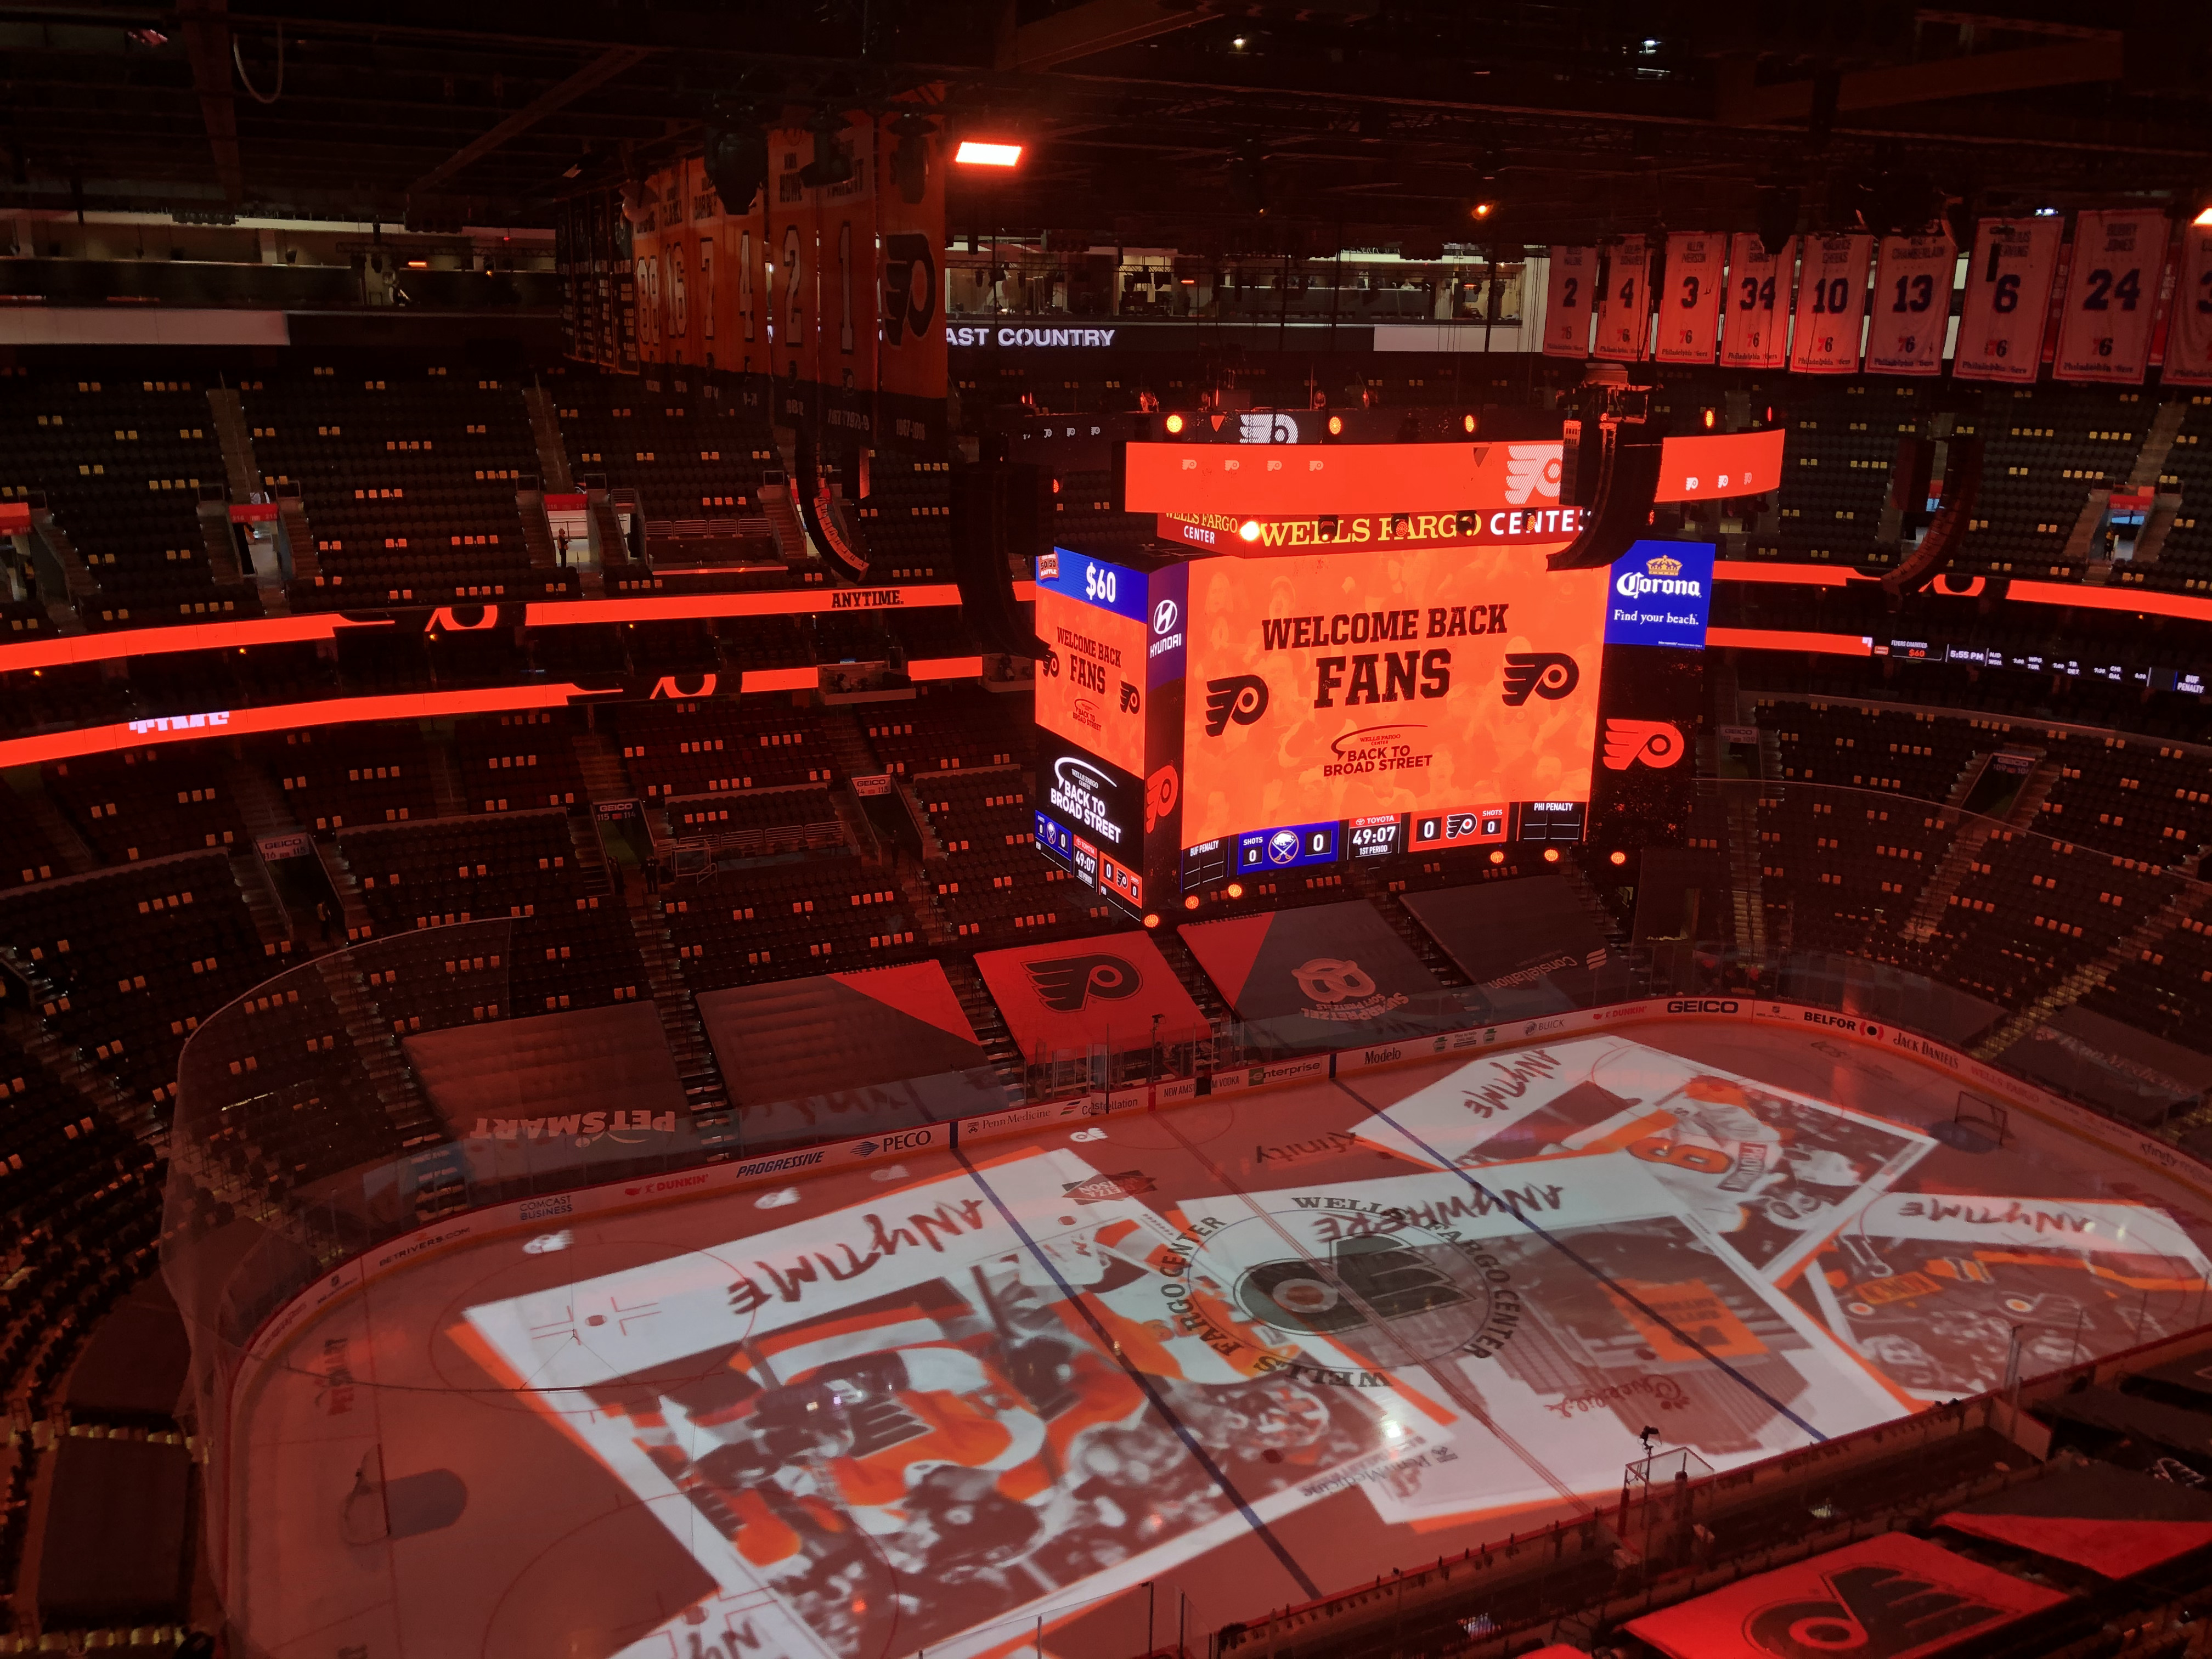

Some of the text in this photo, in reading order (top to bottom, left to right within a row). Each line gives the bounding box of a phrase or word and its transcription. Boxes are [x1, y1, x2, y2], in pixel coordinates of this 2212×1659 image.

[666, 242, 686, 338] 16
[701, 238, 714, 339] 7
[740, 230, 754, 342] 4
[783, 224, 803, 347] 2
[839, 221, 853, 355] 1
[1563, 278, 1578, 307] 2
[1620, 278, 1634, 308] 4
[1680, 276, 1699, 309] 3
[1740, 276, 1775, 311] 34
[1812, 278, 1849, 313] 10
[1893, 274, 1933, 313] 13
[1994, 274, 2021, 313] 6
[2083, 268, 2140, 311] 24
[637, 256, 660, 346] 88
[998, 328, 1115, 347] COUNTRY
[1680, 330, 1692, 344] 76
[1747, 332, 1760, 347] 76
[1818, 336, 1833, 352] 76
[1898, 336, 1915, 353] 76
[2092, 337, 2113, 356] 76
[1201, 513, 1238, 533] FARGO
[1490, 510, 1591, 535] CENTE
[1183, 525, 1216, 545] CENTER
[1086, 562, 1116, 603] $60
[1616, 572, 1701, 599] Corona
[832, 590, 904, 608] ANYTIME.
[1261, 603, 1509, 651] WELCOME BACK
[1613, 609, 1699, 626] Find your beach.
[1057, 626, 1122, 669] WELCOME BACK
[1150, 633, 1182, 658] HYUNDAI
[1909, 648, 1925, 658] $60
[1950, 650, 1984, 661] 5:55 PM
[1070, 653, 1106, 695] FANS
[1314, 648, 1451, 709] FANS
[2185, 674, 2200, 684] BUF
[2177, 682, 2204, 693] PENALTY
[1090, 713, 1096, 722] TO
[1348, 745, 1410, 762] BACK TO
[1071, 768, 1085, 783] WELLS
[1324, 754, 1433, 777] BROAD STREET
[857, 779, 886, 787] GEICO
[599, 804, 633, 812] GEICO
[1064, 781, 1106, 817] BACK TO
[1534, 803, 1573, 811] PHI PENALTY
[597, 813, 610, 822] 115
[1051, 787, 1121, 844] BROAD STREET
[1367, 815, 1395, 824] TOYOTA
[1352, 825, 1396, 845] 49:07
[1424, 821, 1495, 838] 0 0
[265, 838, 302, 850] GEICO
[1060, 833, 1066, 848] 0
[1081, 840, 1095, 855] TOYOTA
[1190, 840, 1219, 857] BUF PENALTY
[1243, 837, 1263, 846] SHOTS
[1249, 834, 1323, 862] 0 0
[1359, 845, 1387, 855] 1ST PERIOD
[1075, 850, 1096, 874] 49:07
[1106, 863, 1111, 878] 0
[1132, 885, 1137, 896] 0
[1487, 956, 1578, 989] Constellation
[1666, 1000, 1739, 1014] GEICO
[1539, 1019, 1565, 1031] BUICK
[1804, 1011, 1856, 1031] BELFOR
[1894, 1032, 1918, 1052] JACK
[1365, 1047, 1401, 1064] Modelo
[1164, 1076, 1240, 1098] NEW VODKA
[470, 1110, 676, 1140] PETSMART
[983, 1110, 1051, 1130] Penn Medicine
[883, 1131, 931, 1152] PECO
[736, 1151, 826, 1178] PROGRESSIVE
[657, 1174, 709, 1191] DUNKIN'
[520, 1195, 571, 1211] COMCAST
[521, 1204, 573, 1221] BUSINESS
[1463, 1289, 1521, 1360] CENTER
